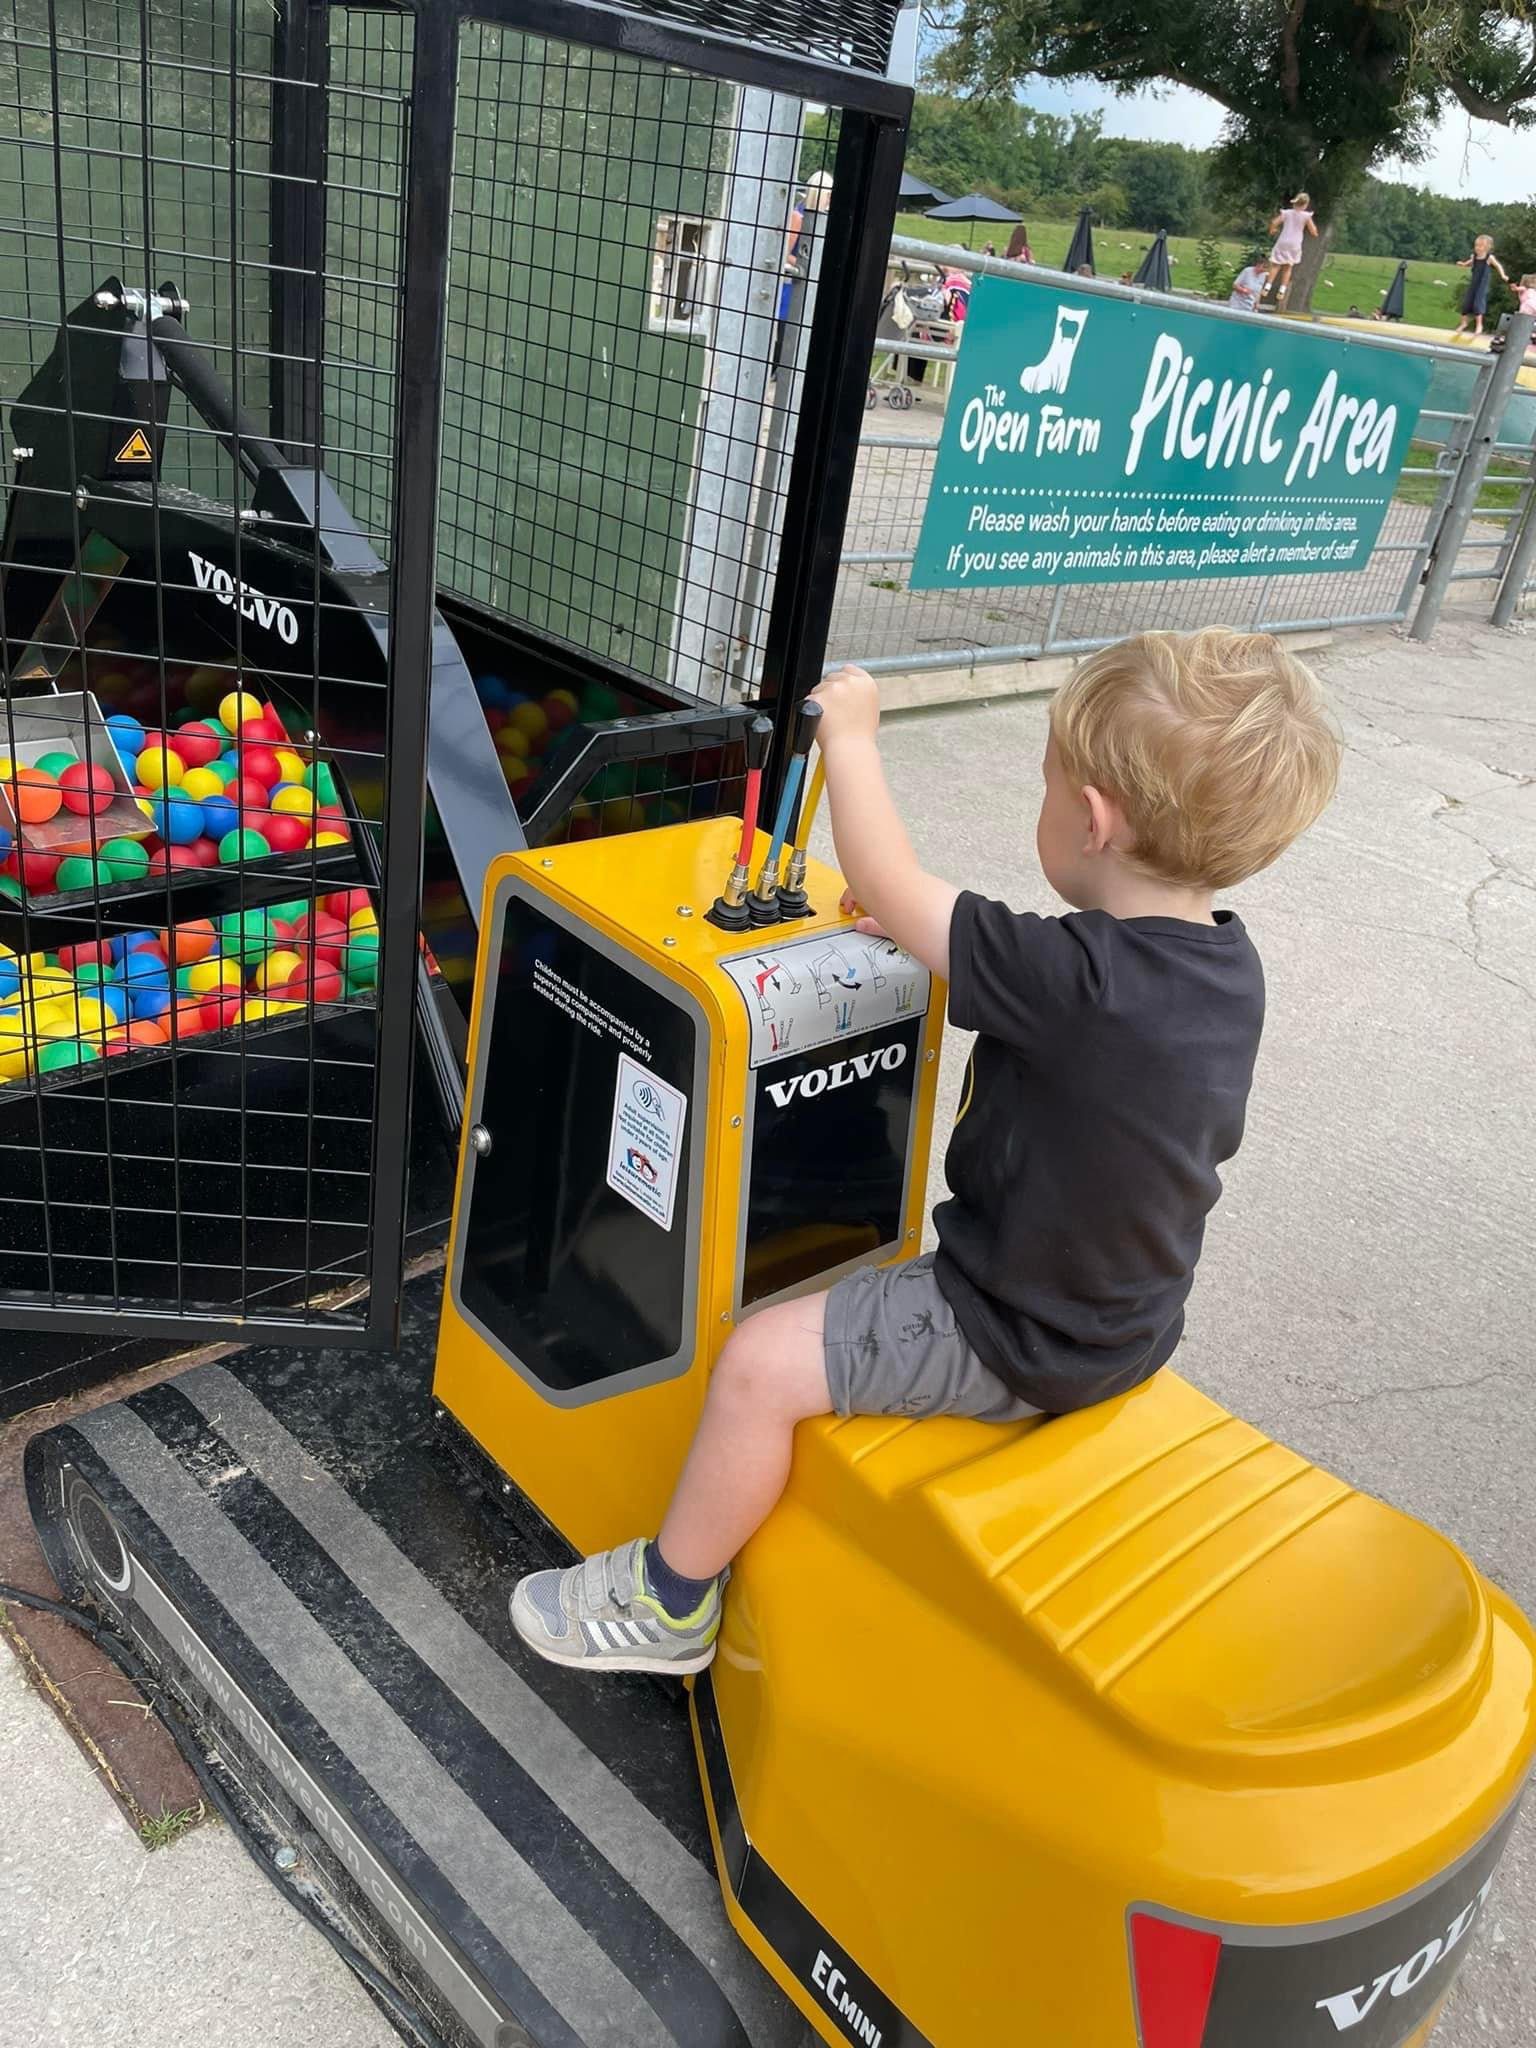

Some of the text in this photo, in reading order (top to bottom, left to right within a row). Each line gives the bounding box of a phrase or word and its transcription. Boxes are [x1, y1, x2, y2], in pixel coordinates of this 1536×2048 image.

[984, 384, 1006, 407] The
[1124, 332, 1398, 486] Picnic Area
[960, 397, 1101, 465] Open Farm
[968, 504, 1025, 532] Please
[1029, 506, 1070, 532] wash
[1069, 513, 1108, 539] your
[1110, 507, 1155, 532] hands
[1156, 508, 1200, 532] before
[1202, 510, 1241, 538] eating
[1242, 517, 1256, 532] or
[1257, 510, 1302, 537] drinking
[1302, 512, 1314, 531] in
[1314, 511, 1333, 531] this
[946, 539, 1359, 579] If you see any animals in this area, please alert a member of staff
[188, 551, 299, 645] VOLVO
[533, 982, 603, 1038] seated during the ride.
[534, 971, 652, 1062] supervising companion and properly
[535, 959, 650, 1047] Children must be accompanied by a
[765, 1043, 907, 1108] VOLVO
[181, 1635, 428, 1958] www.sbisweden.com
